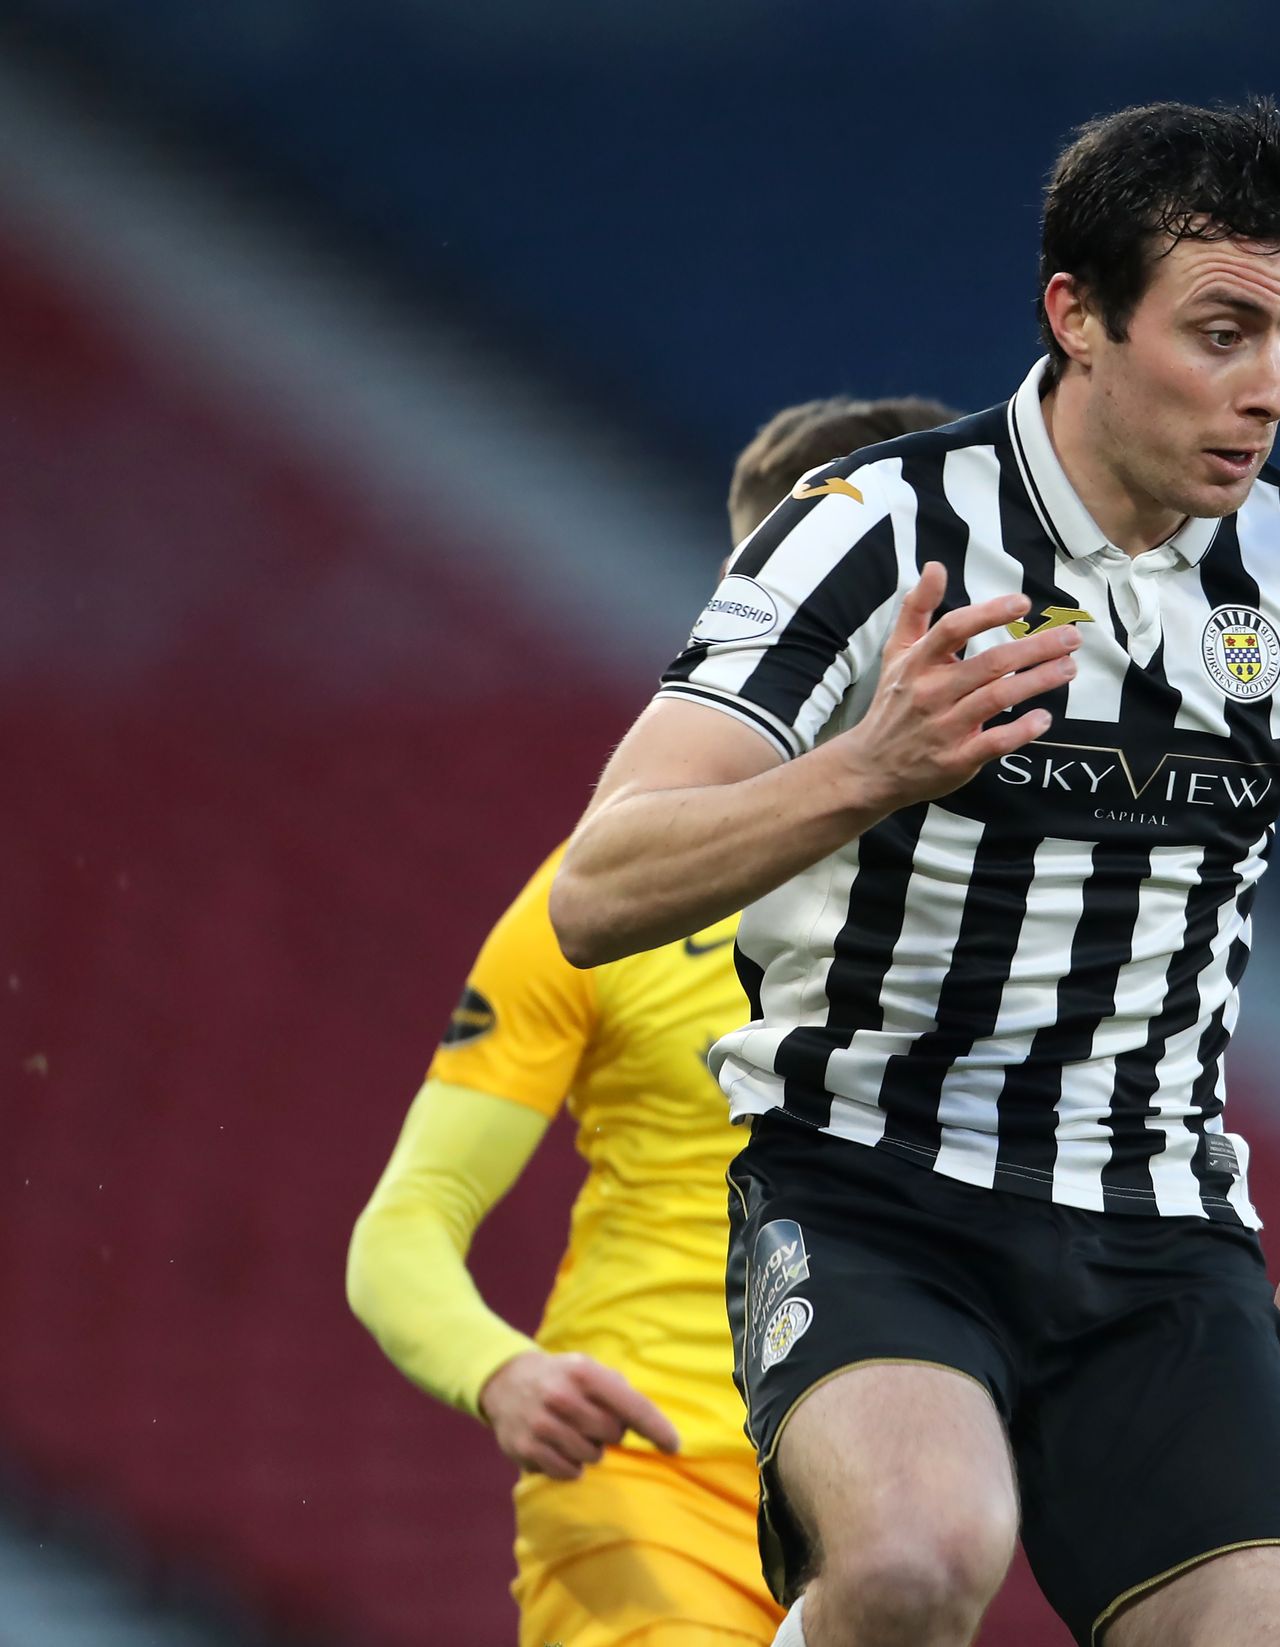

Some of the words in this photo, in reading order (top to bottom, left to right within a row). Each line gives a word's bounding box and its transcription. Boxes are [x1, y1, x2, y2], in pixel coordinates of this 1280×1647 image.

[706, 599, 773, 624] REMIERSHIP
[1205, 646, 1234, 689] MIRREN
[1235, 659, 1278, 694] FOOTBALL
[1260, 626, 1278, 656] CLUB
[996, 749, 1273, 808] SKYVIEW
[1094, 808, 1169, 827] CAPITAL
